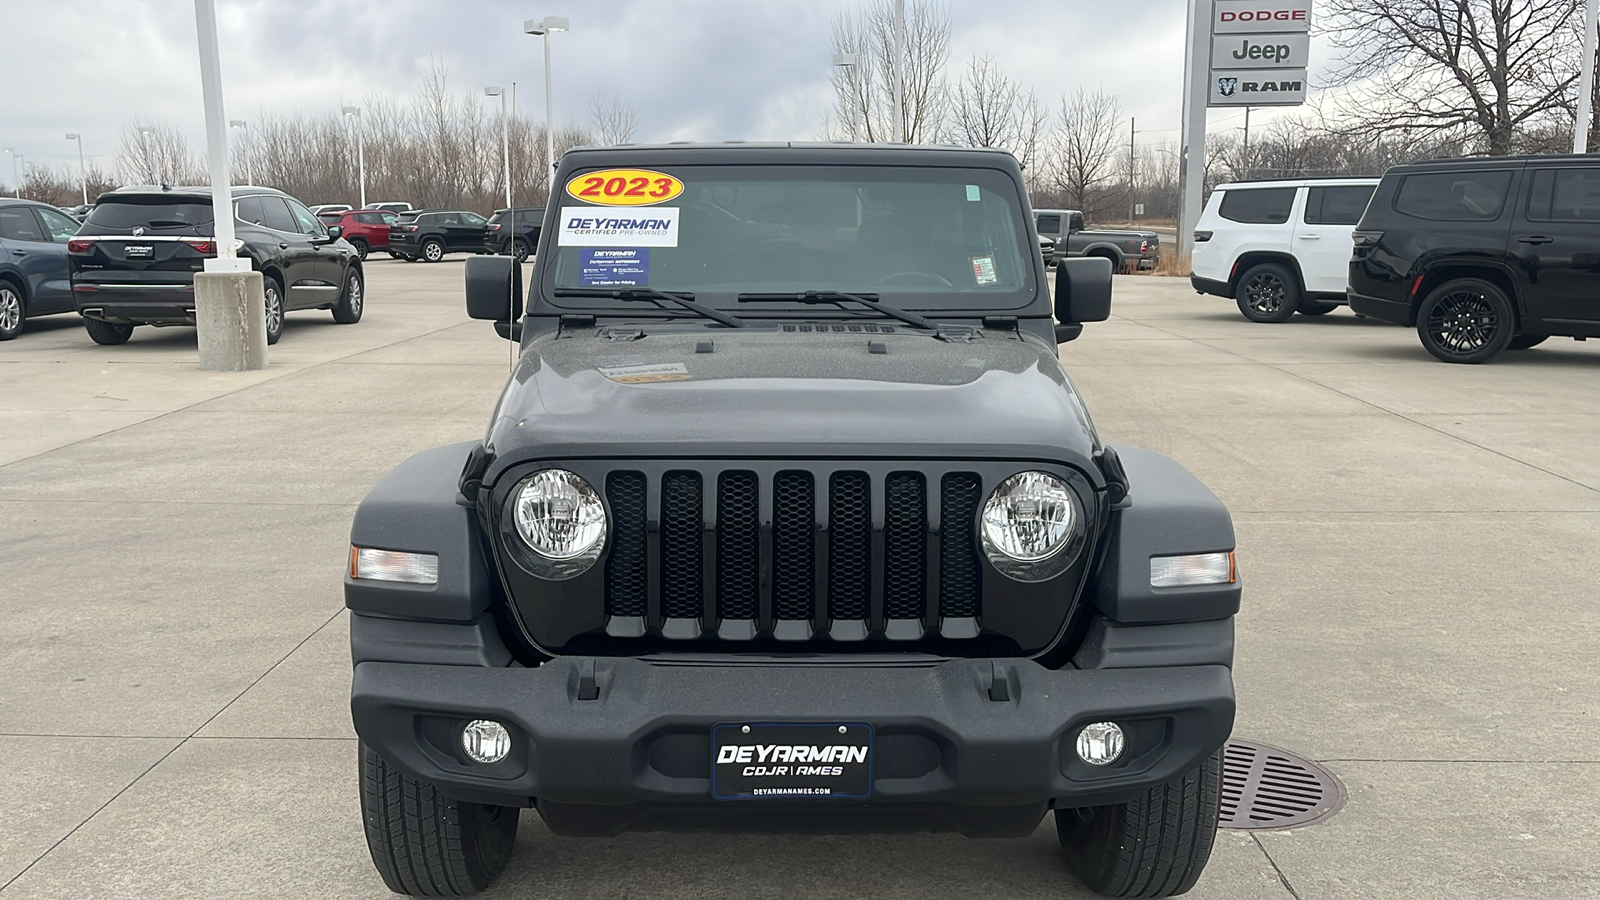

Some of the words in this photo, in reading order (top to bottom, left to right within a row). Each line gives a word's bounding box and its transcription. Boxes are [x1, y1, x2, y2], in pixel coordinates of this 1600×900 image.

[1220, 10, 1307, 22] DODGE
[1232, 40, 1290, 63] Jeep
[1242, 81, 1302, 92] RAM
[578, 177, 673, 198] 2023
[567, 217, 671, 230] DEYARMAN
[716, 745, 868, 764] DEYARMAN
[753, 788, 831, 796] DEYARMANAMES.COM
